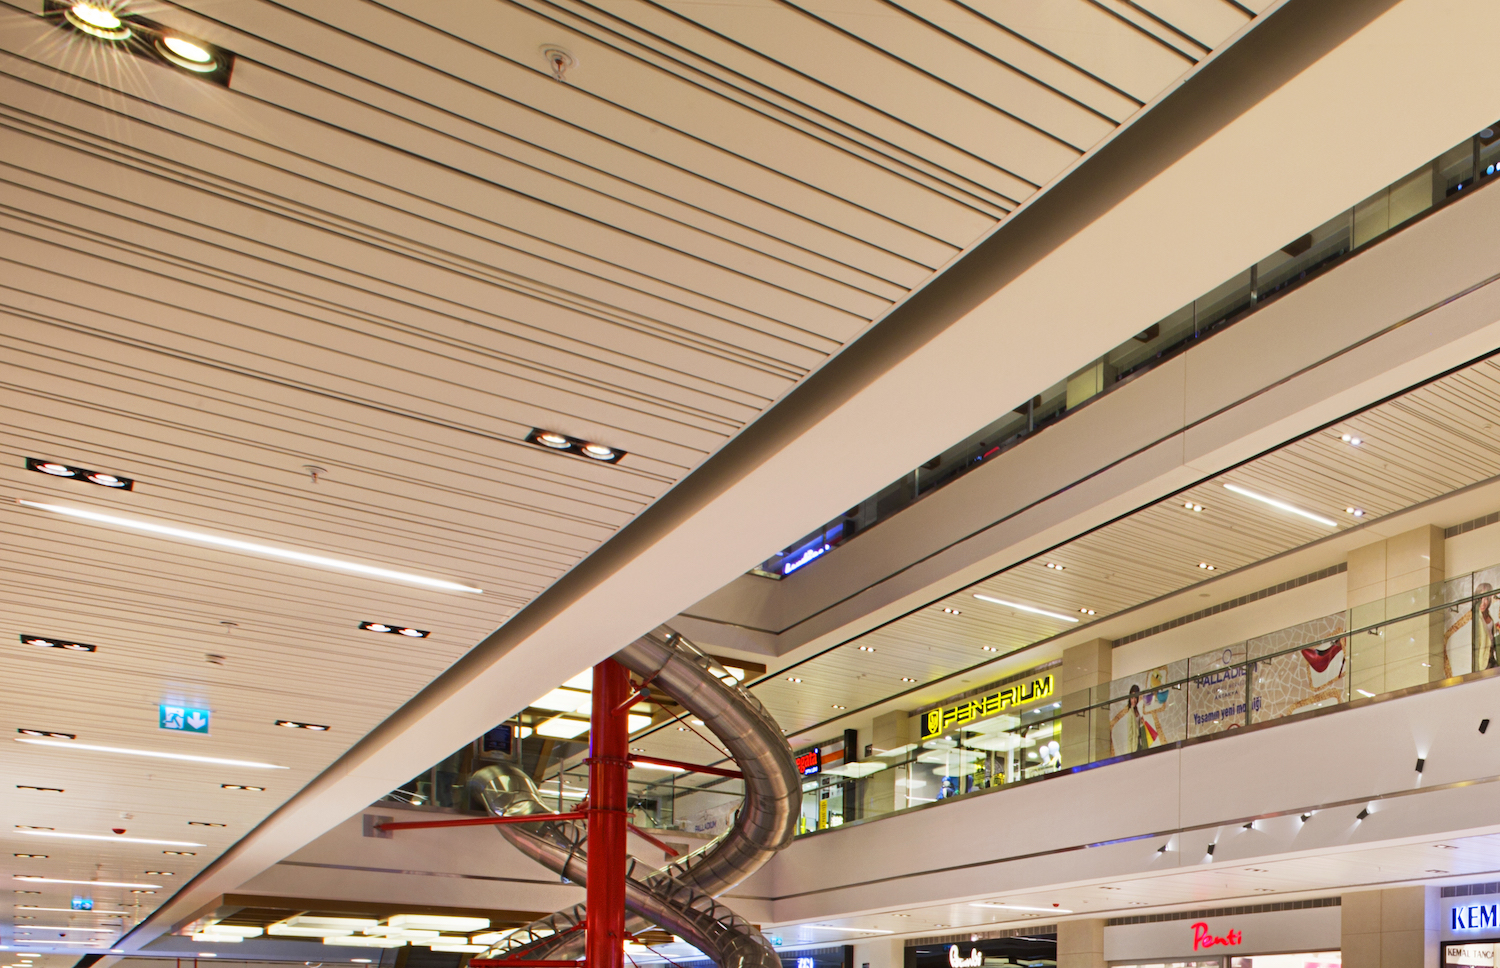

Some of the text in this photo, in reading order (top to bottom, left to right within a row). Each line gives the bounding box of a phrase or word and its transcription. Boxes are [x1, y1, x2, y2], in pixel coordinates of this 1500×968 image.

[1221, 703, 1235, 720] yeni
[1236, 696, 1262, 714] moiği
[1191, 922, 1242, 951] Penti
